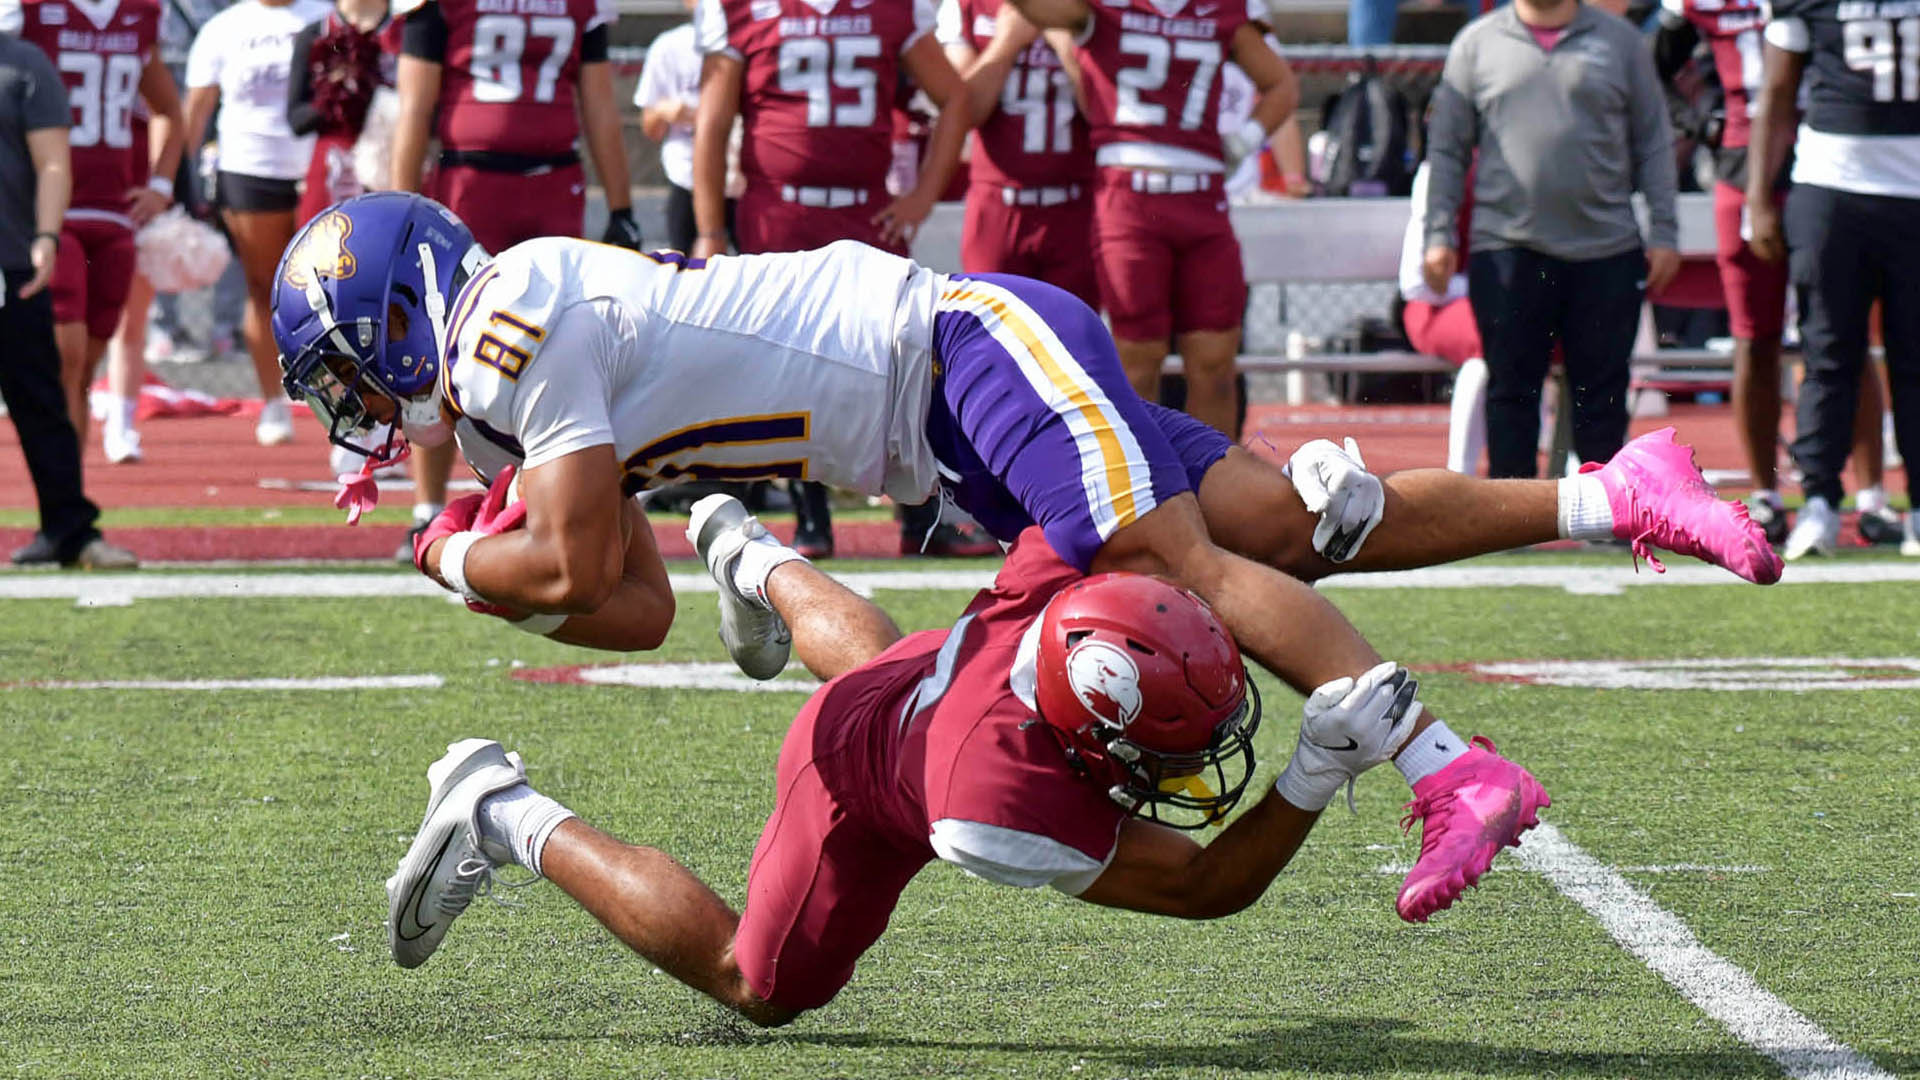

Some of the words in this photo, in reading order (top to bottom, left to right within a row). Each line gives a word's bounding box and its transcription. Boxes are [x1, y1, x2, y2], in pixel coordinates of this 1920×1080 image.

[58, 52, 143, 148] 38
[470, 15, 576, 103] 87
[778, 36, 881, 126] 95
[1115, 32, 1221, 130] 27
[1843, 18, 1919, 101] 91
[1002, 67, 1074, 153] 41
[473, 309, 546, 384] 81
